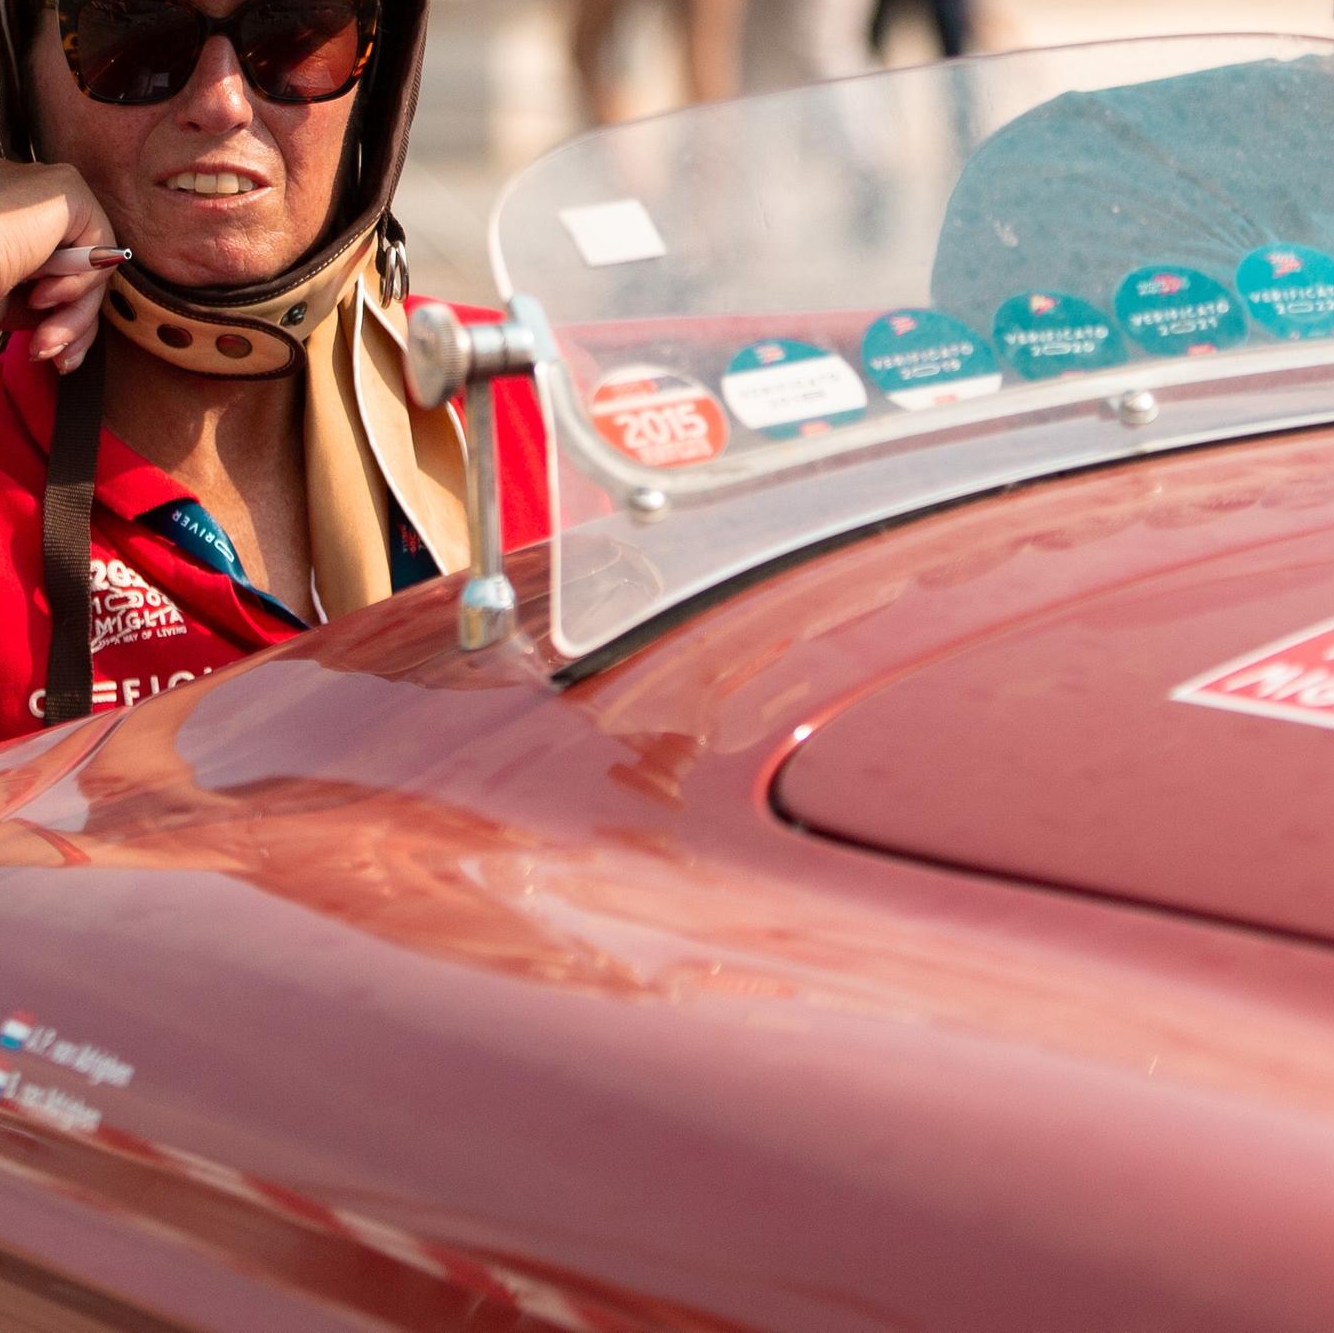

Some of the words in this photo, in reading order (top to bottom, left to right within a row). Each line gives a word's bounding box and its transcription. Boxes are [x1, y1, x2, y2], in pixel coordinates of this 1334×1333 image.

[1130, 297, 1230, 327] VERIFICATO
[1003, 325, 1109, 346] VERIFICATO
[612, 403, 710, 449] 2015
[172, 508, 235, 563] DRIVER
[95, 609, 184, 636] MIGLIA
[141, 630, 153, 640] OF
[157, 624, 187, 639] LIVING
